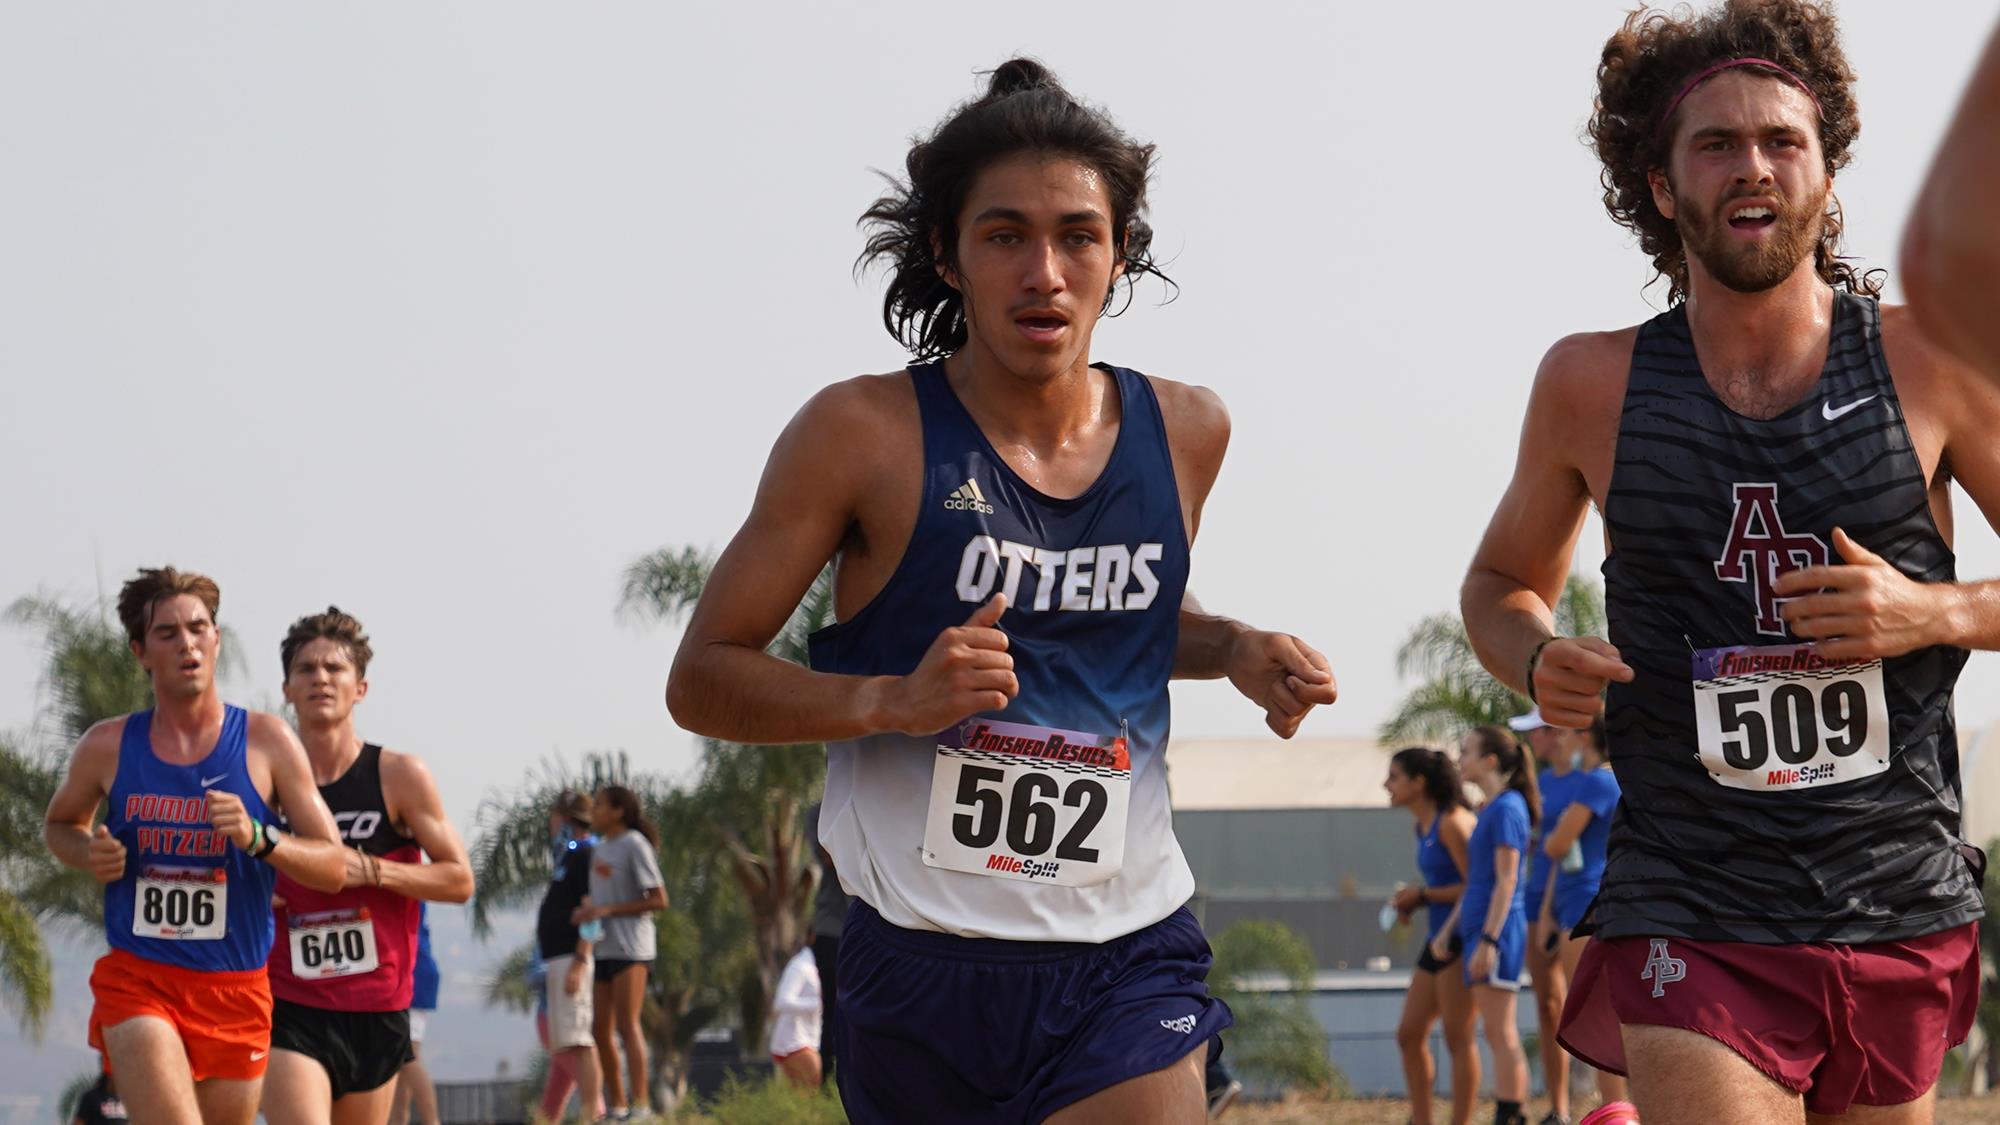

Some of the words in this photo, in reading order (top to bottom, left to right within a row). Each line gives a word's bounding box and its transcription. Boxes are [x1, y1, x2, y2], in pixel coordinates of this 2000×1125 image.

[944, 498, 994, 514] adidas
[955, 535, 1163, 612] OTTERS
[1717, 680, 1868, 771] 509
[1766, 762, 1836, 785] MileSplit
[952, 764, 1108, 864] 562
[137, 826, 227, 857] PITZER
[986, 854, 1060, 878] MileSplit
[143, 887, 215, 927] 806
[301, 929, 366, 968] 640
